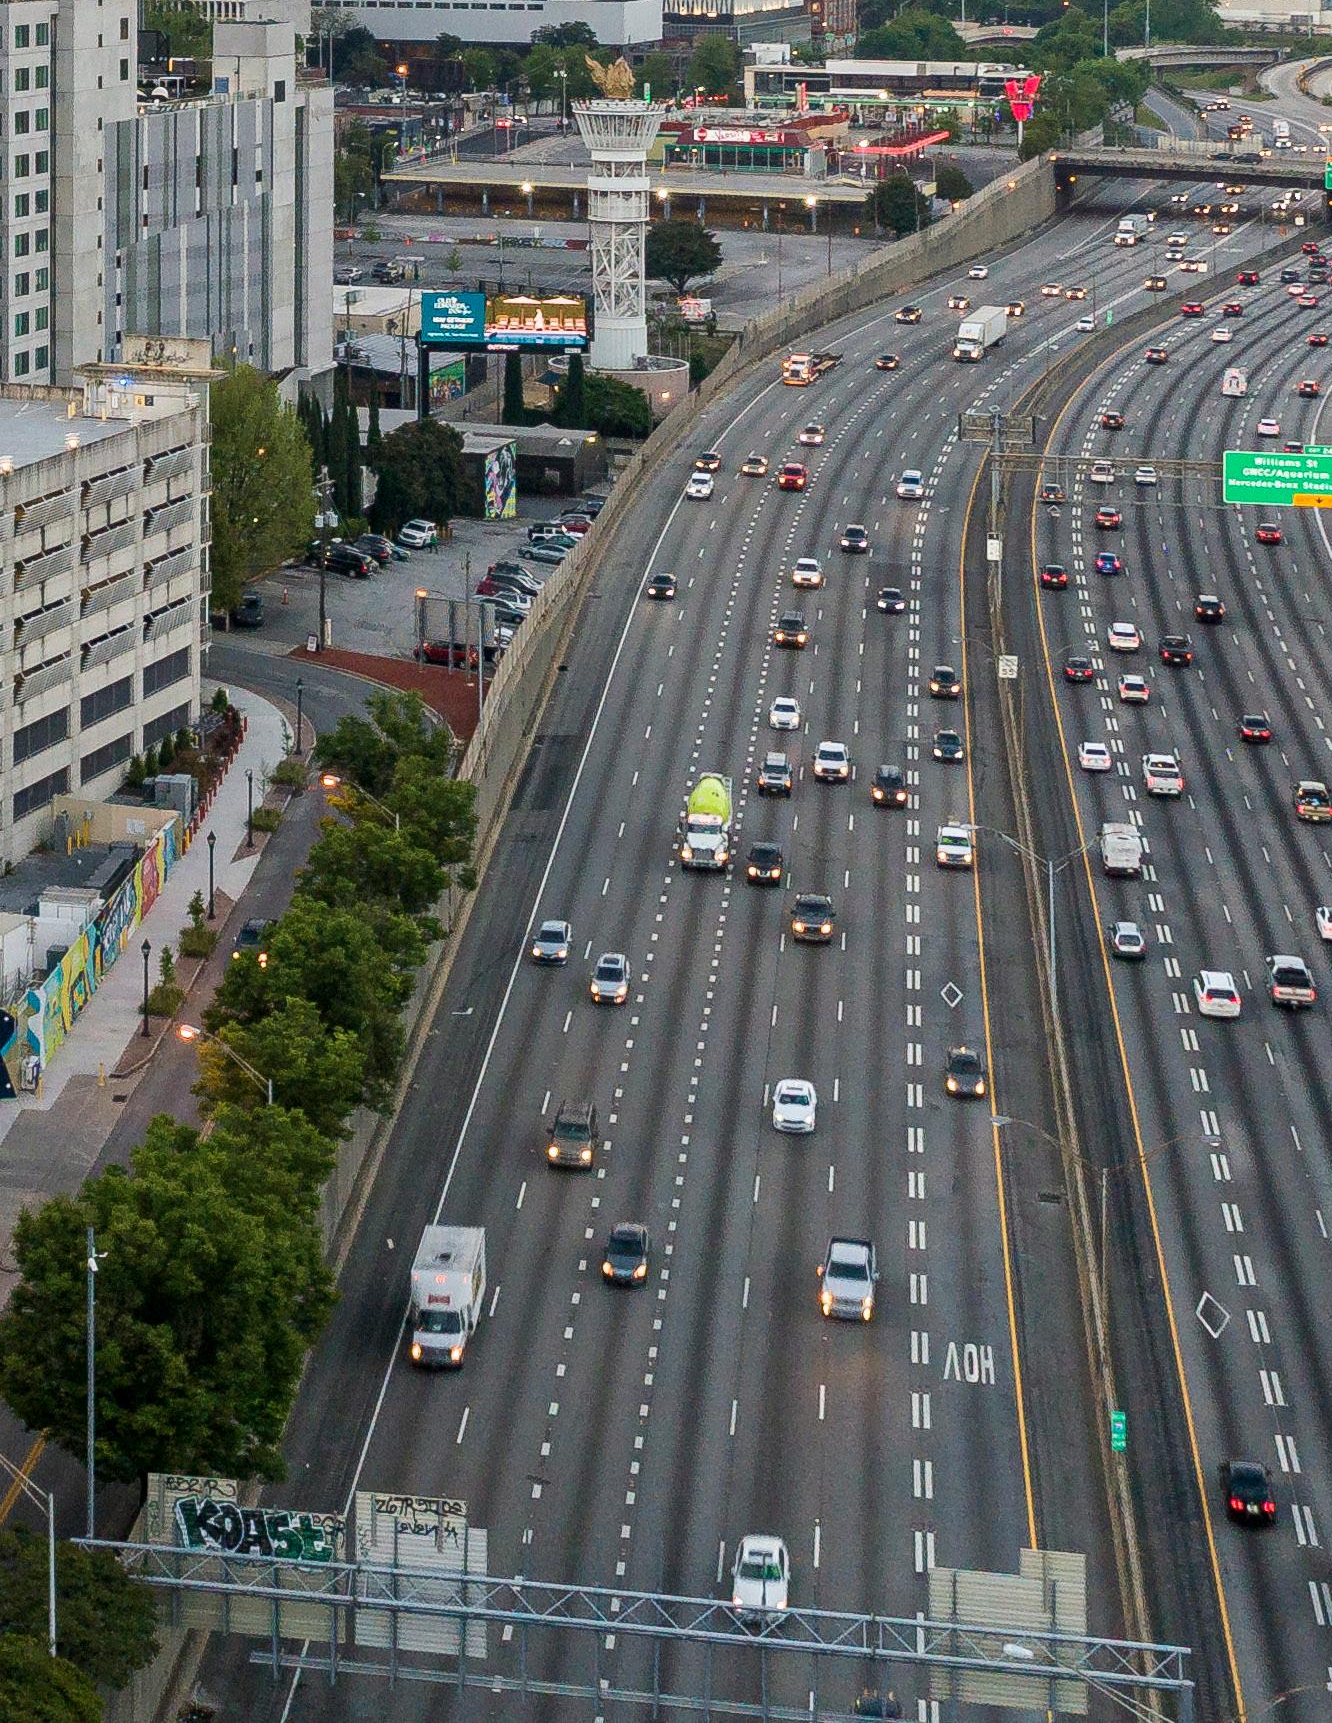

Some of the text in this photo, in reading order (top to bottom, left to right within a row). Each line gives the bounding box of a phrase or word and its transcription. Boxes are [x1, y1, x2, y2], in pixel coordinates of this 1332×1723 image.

[1254, 457, 1319, 468] Williams St
[1242, 467, 1330, 480] GWCC/Aquarium
[943, 1341, 996, 1385] HOV
